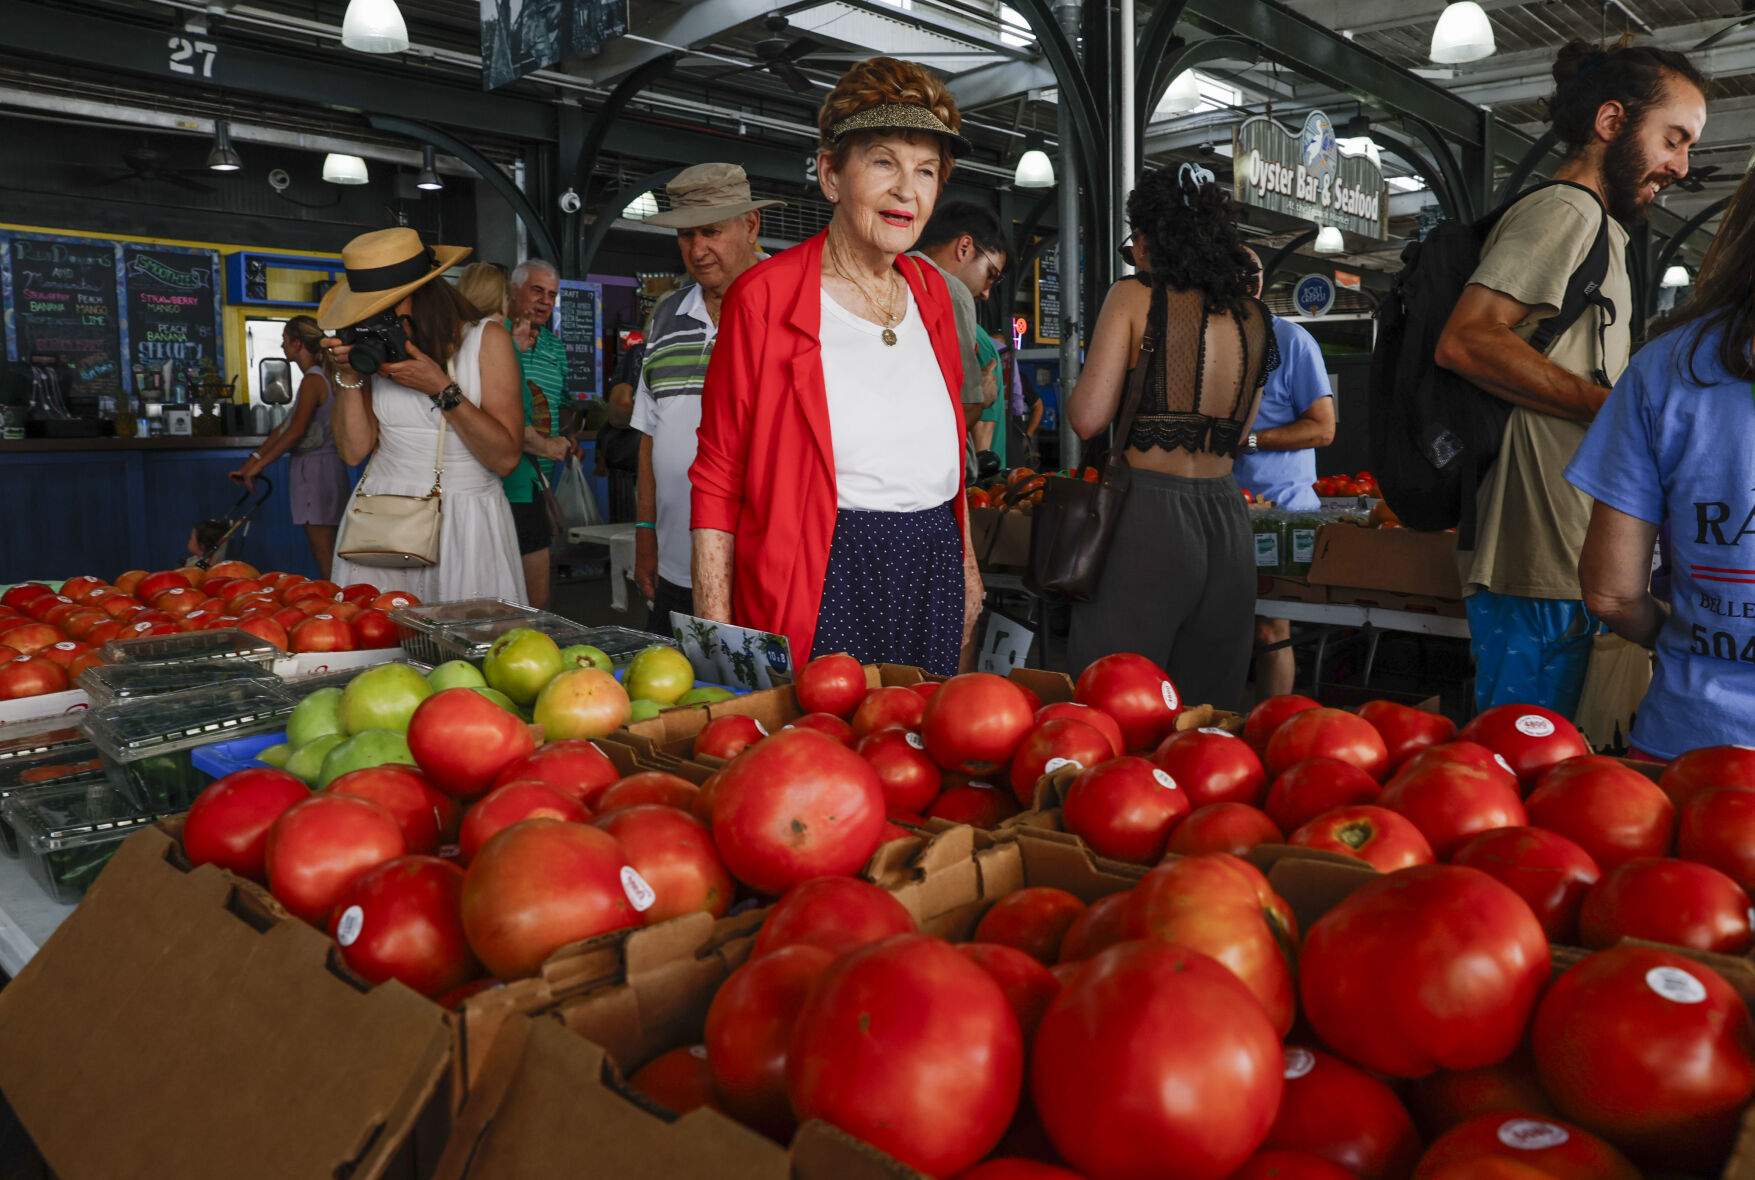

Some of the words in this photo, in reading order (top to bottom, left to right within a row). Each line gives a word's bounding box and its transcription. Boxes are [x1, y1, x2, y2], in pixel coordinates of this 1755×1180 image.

[168, 37, 217, 77] 27
[1250, 148, 1294, 198] Oyster
[1296, 162, 1319, 204] Bar
[1321, 172, 1332, 207] &
[1334, 176, 1379, 222] Seafood
[138, 255, 200, 287] SMOOTHIES
[140, 292, 198, 305] STRAWBERRY
[29, 301, 65, 312] BANANA
[75, 304, 107, 316] MANGO
[81, 314, 105, 326] LIME
[158, 324, 188, 334] PEACH
[146, 330, 188, 342] BANANA
[1690, 623, 1755, 665] 504
